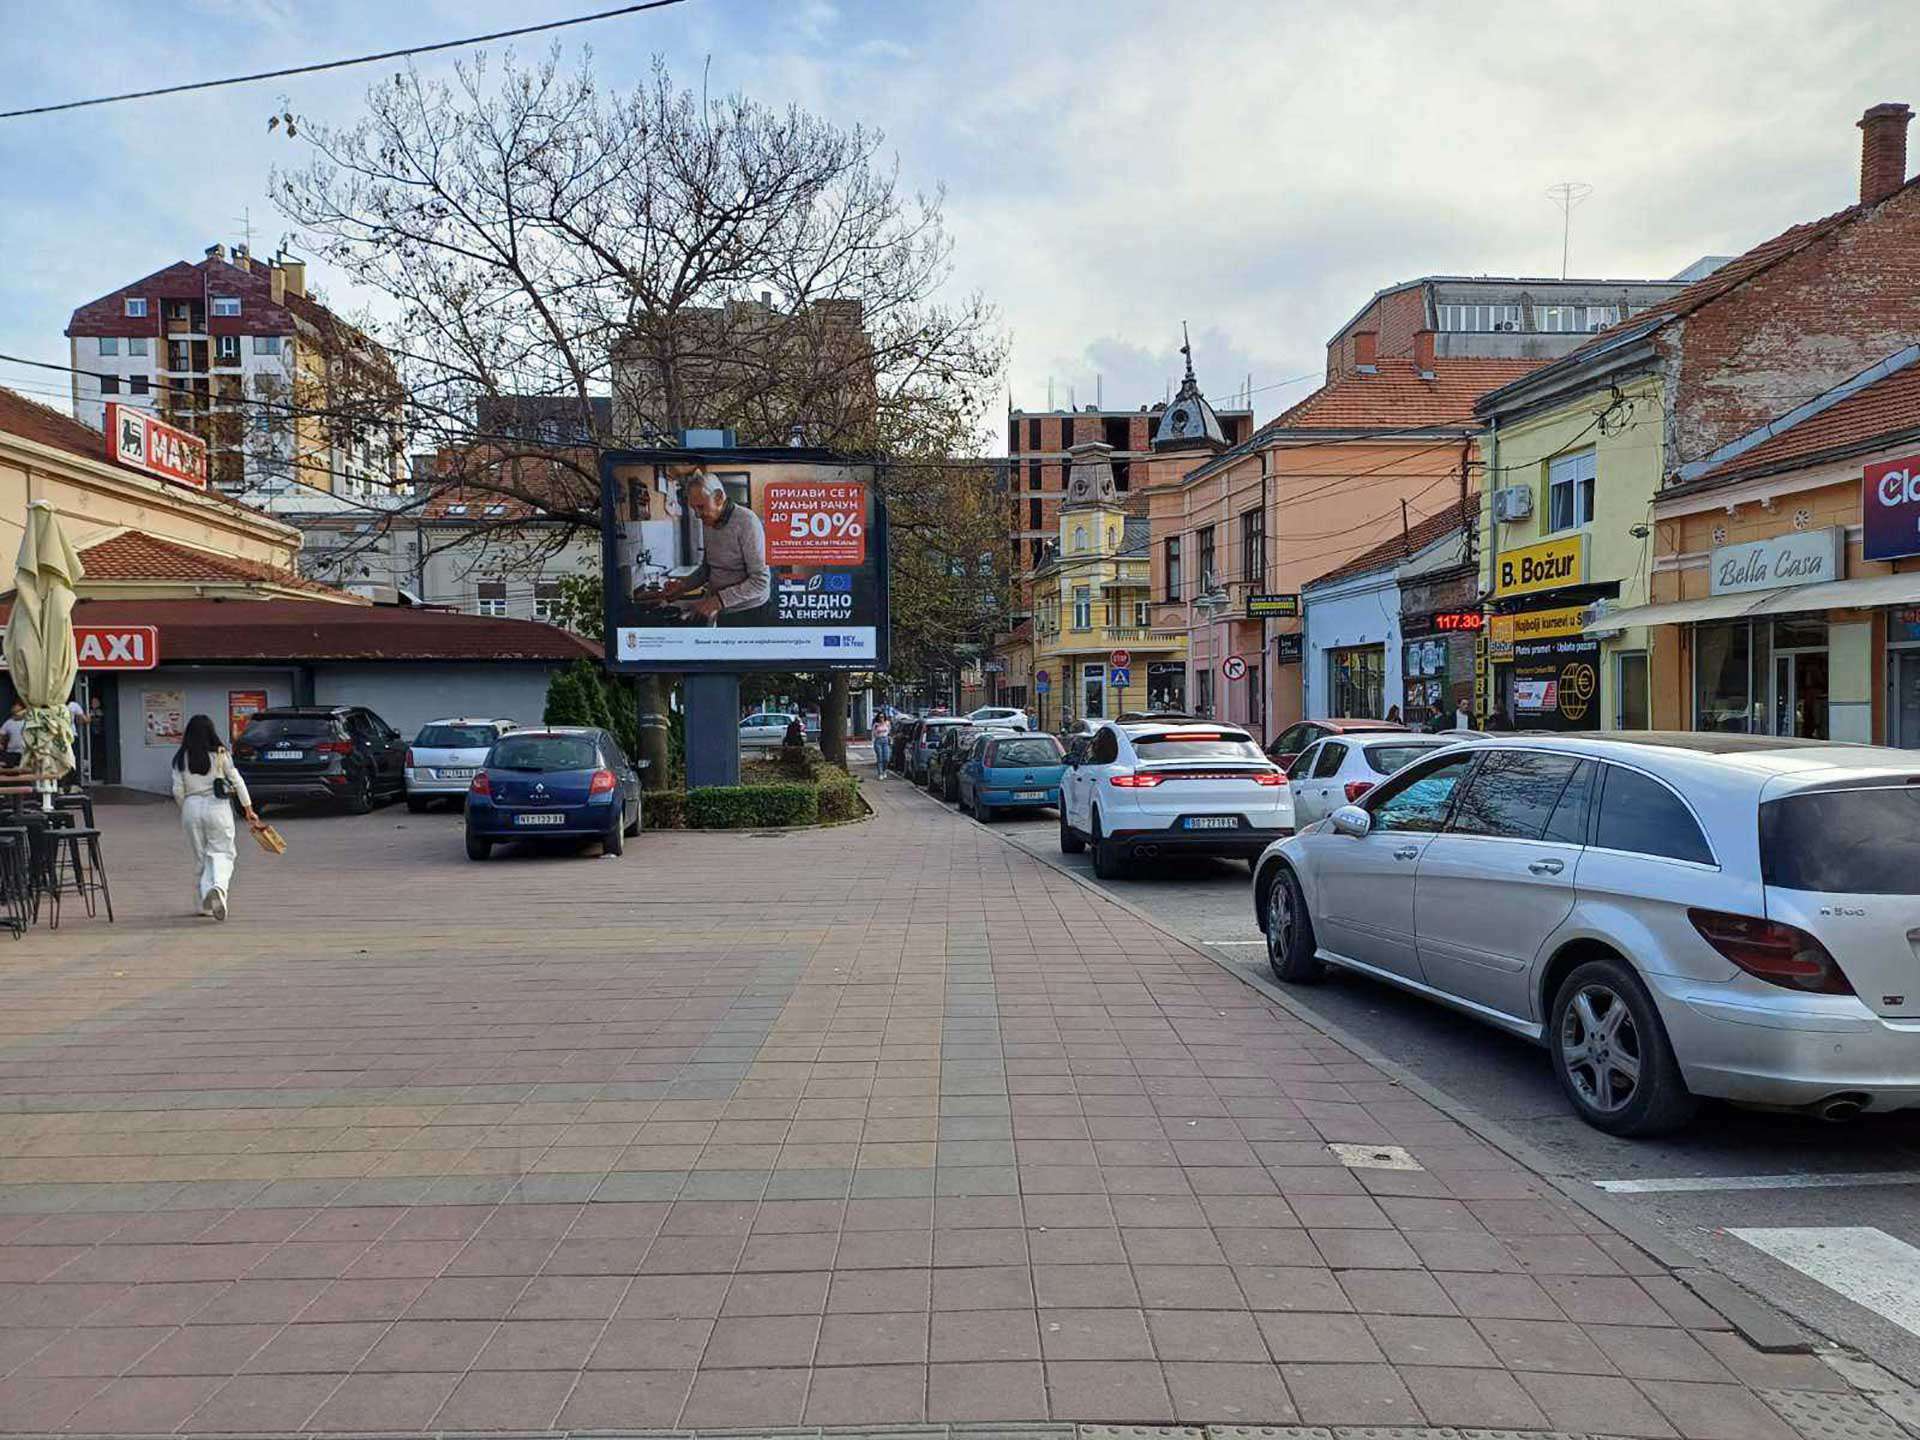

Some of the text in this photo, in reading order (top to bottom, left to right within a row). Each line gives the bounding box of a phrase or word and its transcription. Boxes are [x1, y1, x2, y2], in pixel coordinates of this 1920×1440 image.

[771, 488, 858, 498] ПРИЈАВИ СЕ И
[771, 501, 858, 510] УМАЊИ РАЧУН
[771, 512, 862, 538] ДО 50%
[1502, 552, 1575, 588] B. Božur
[1719, 548, 1823, 586] Bella Casa
[779, 594, 852, 609] ЗАЈЕДНО
[779, 610, 851, 620] ЗА ЕНЕРГИЈУ
[1436, 614, 1481, 629] 117.30
[79, 634, 144, 662] AXI
[1113, 654, 1128, 662] STOP
